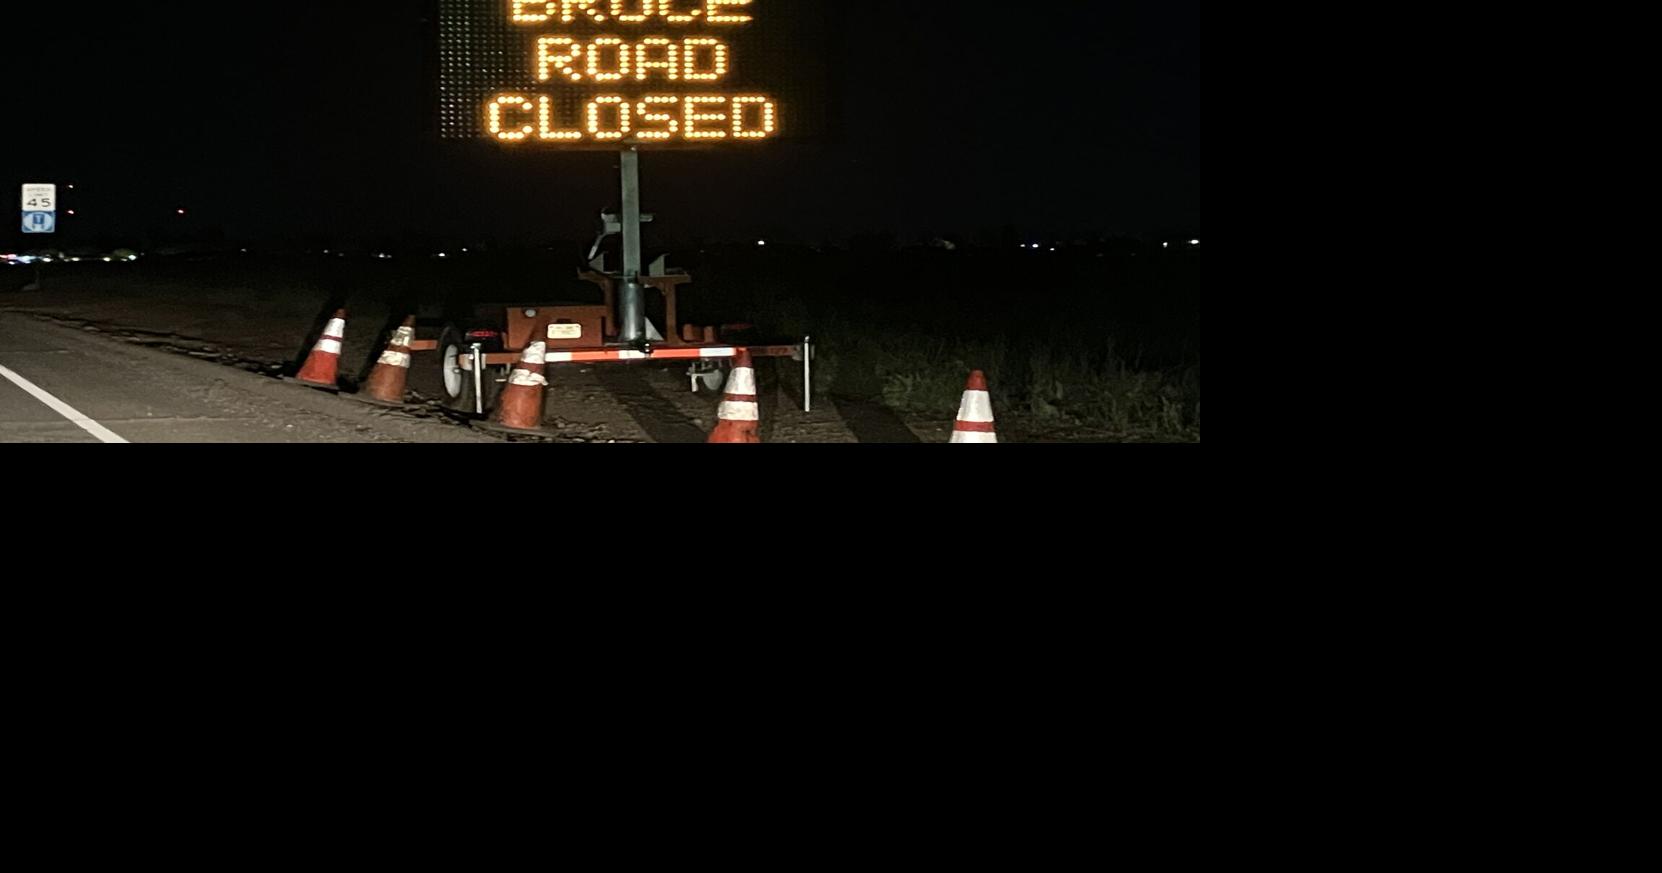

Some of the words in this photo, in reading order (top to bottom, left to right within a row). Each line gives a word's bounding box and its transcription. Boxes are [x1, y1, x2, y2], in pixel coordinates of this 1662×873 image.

[537, 37, 728, 81] ROAD
[489, 95, 774, 139] CLOSED
[26, 197, 51, 207] 45
